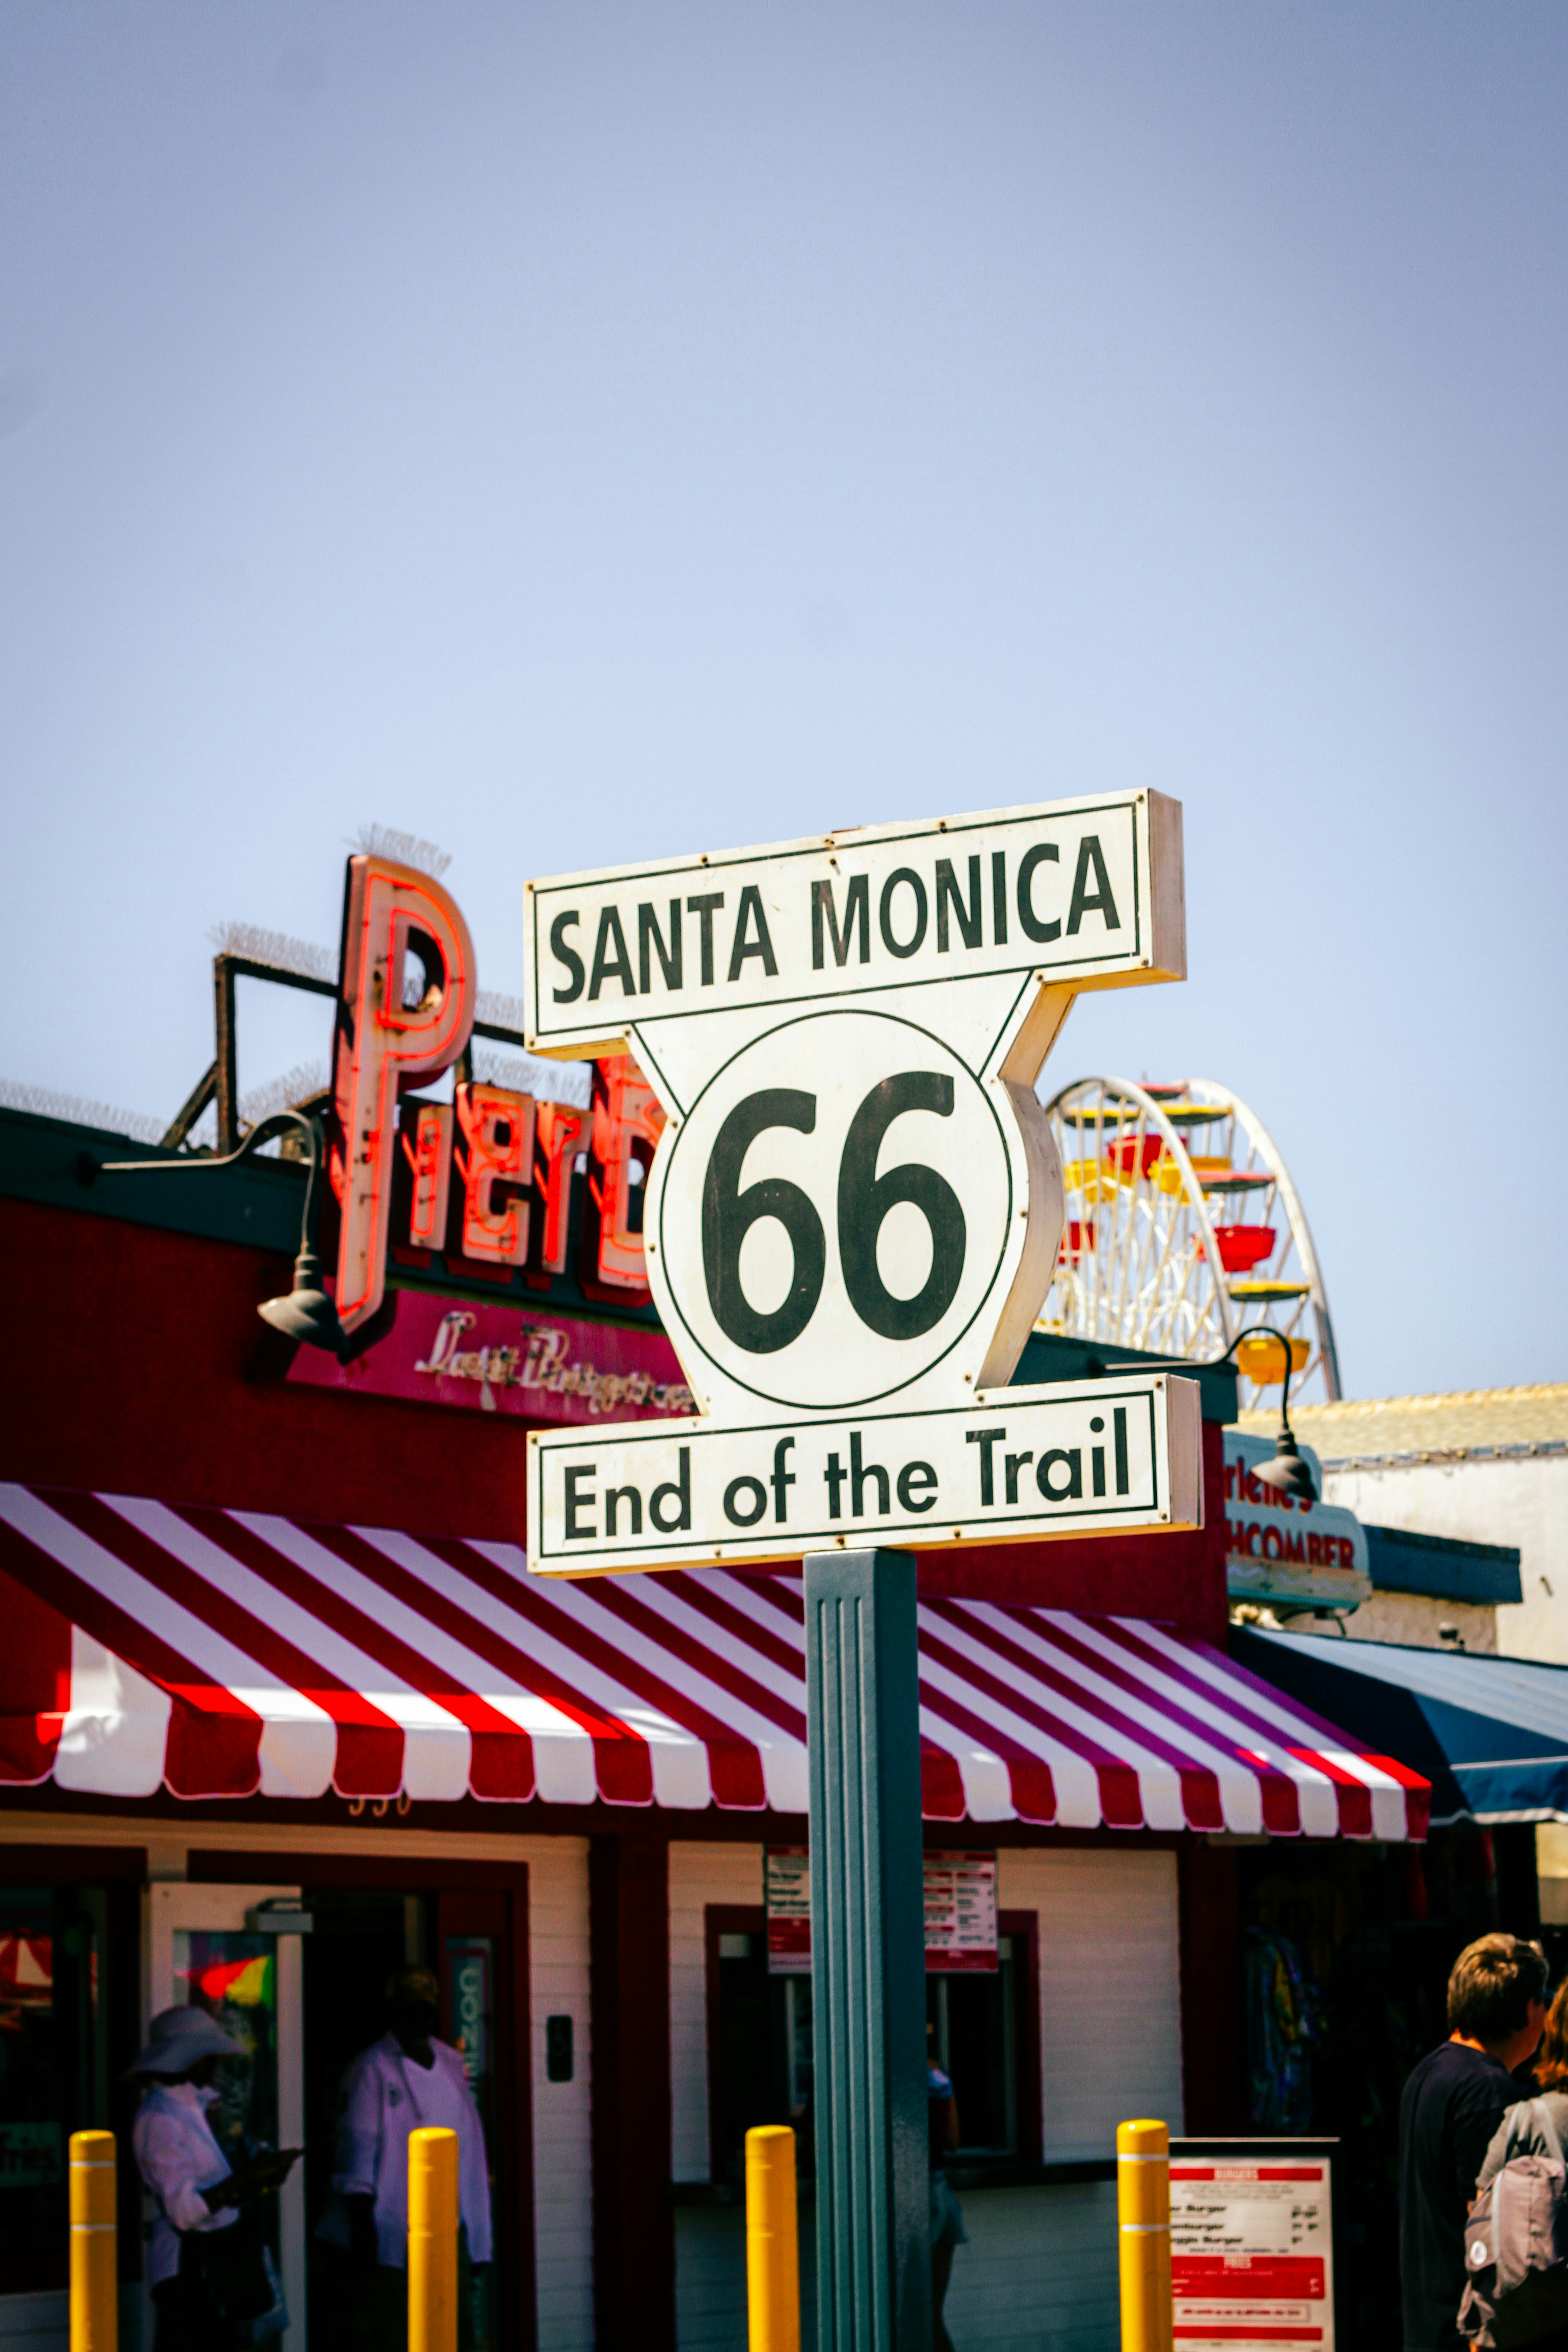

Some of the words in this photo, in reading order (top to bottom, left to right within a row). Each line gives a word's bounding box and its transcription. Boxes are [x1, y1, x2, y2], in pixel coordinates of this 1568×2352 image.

[550, 885, 779, 1004] SANTA
[810, 835, 1121, 971] MONICA
[337, 854, 593, 1331] Pier
[701, 1071, 967, 1354] 66
[564, 1447, 691, 1541] End
[723, 1436, 796, 1527] of
[824, 1431, 938, 1520] the
[966, 1407, 1131, 1507] Trail
